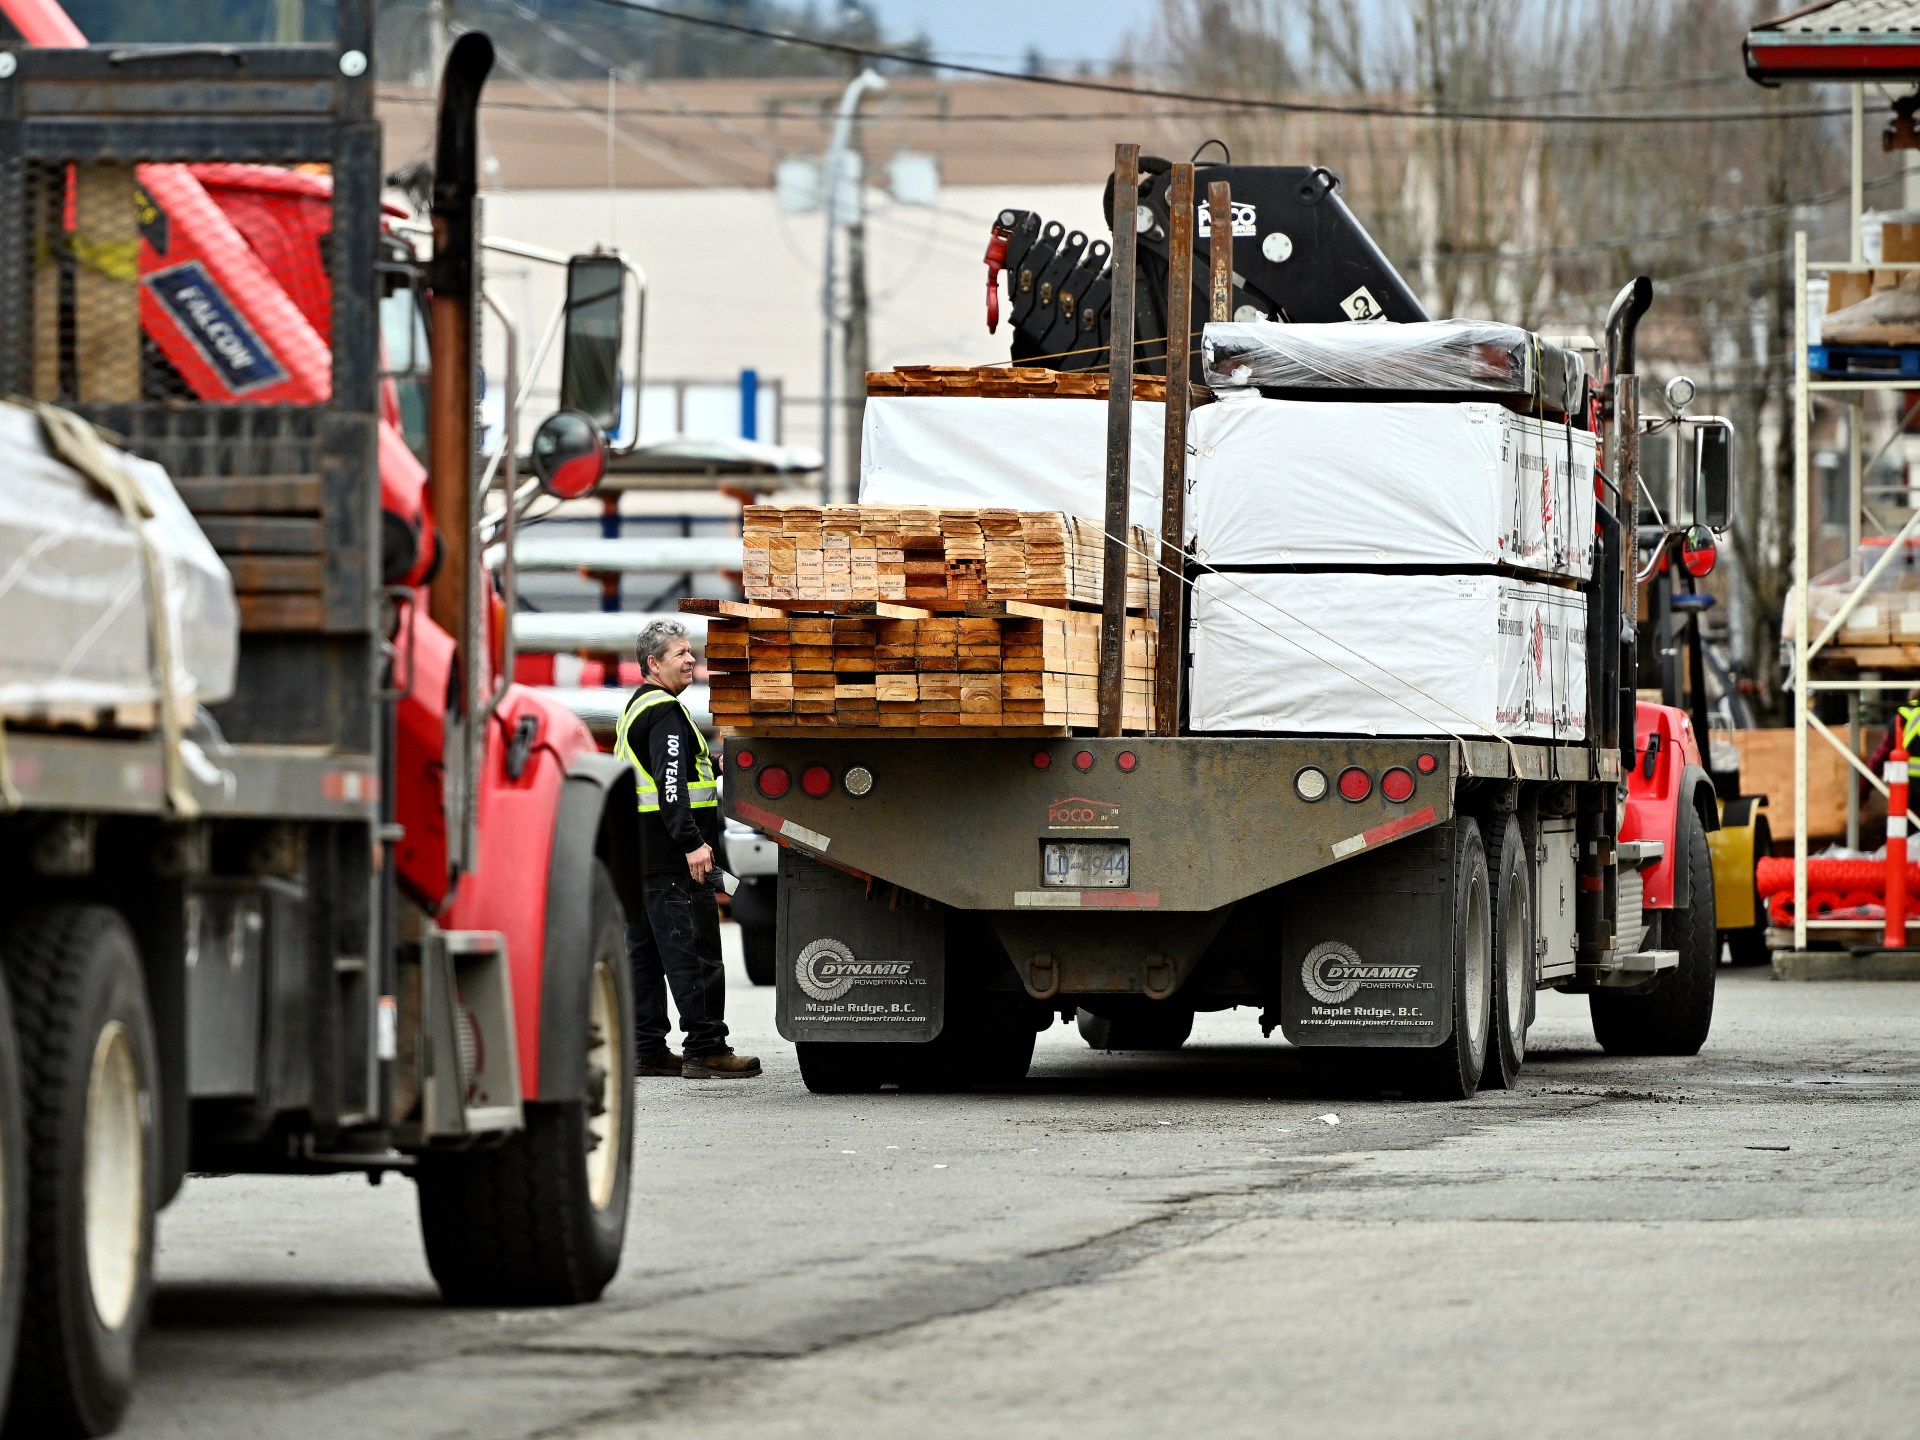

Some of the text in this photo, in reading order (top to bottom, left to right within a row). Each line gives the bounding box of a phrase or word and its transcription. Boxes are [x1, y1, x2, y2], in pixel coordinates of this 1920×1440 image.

[177, 285, 255, 370] FALCON
[665, 734, 680, 803] 100 YEARS
[1048, 808, 1094, 822] POCO
[821, 964, 911, 975] DYNAMIC
[1327, 967, 1419, 979] DYNAMIC
[805, 1003, 845, 1014] Maple
[891, 1003, 916, 1013] B.C.
[1311, 1006, 1352, 1017] Maple
[1398, 1007, 1423, 1016] B.C.
[794, 1014, 926, 1023] www.dynamicpowertrain.com
[1299, 1018, 1434, 1027] www.dynamicpowertrain.com
